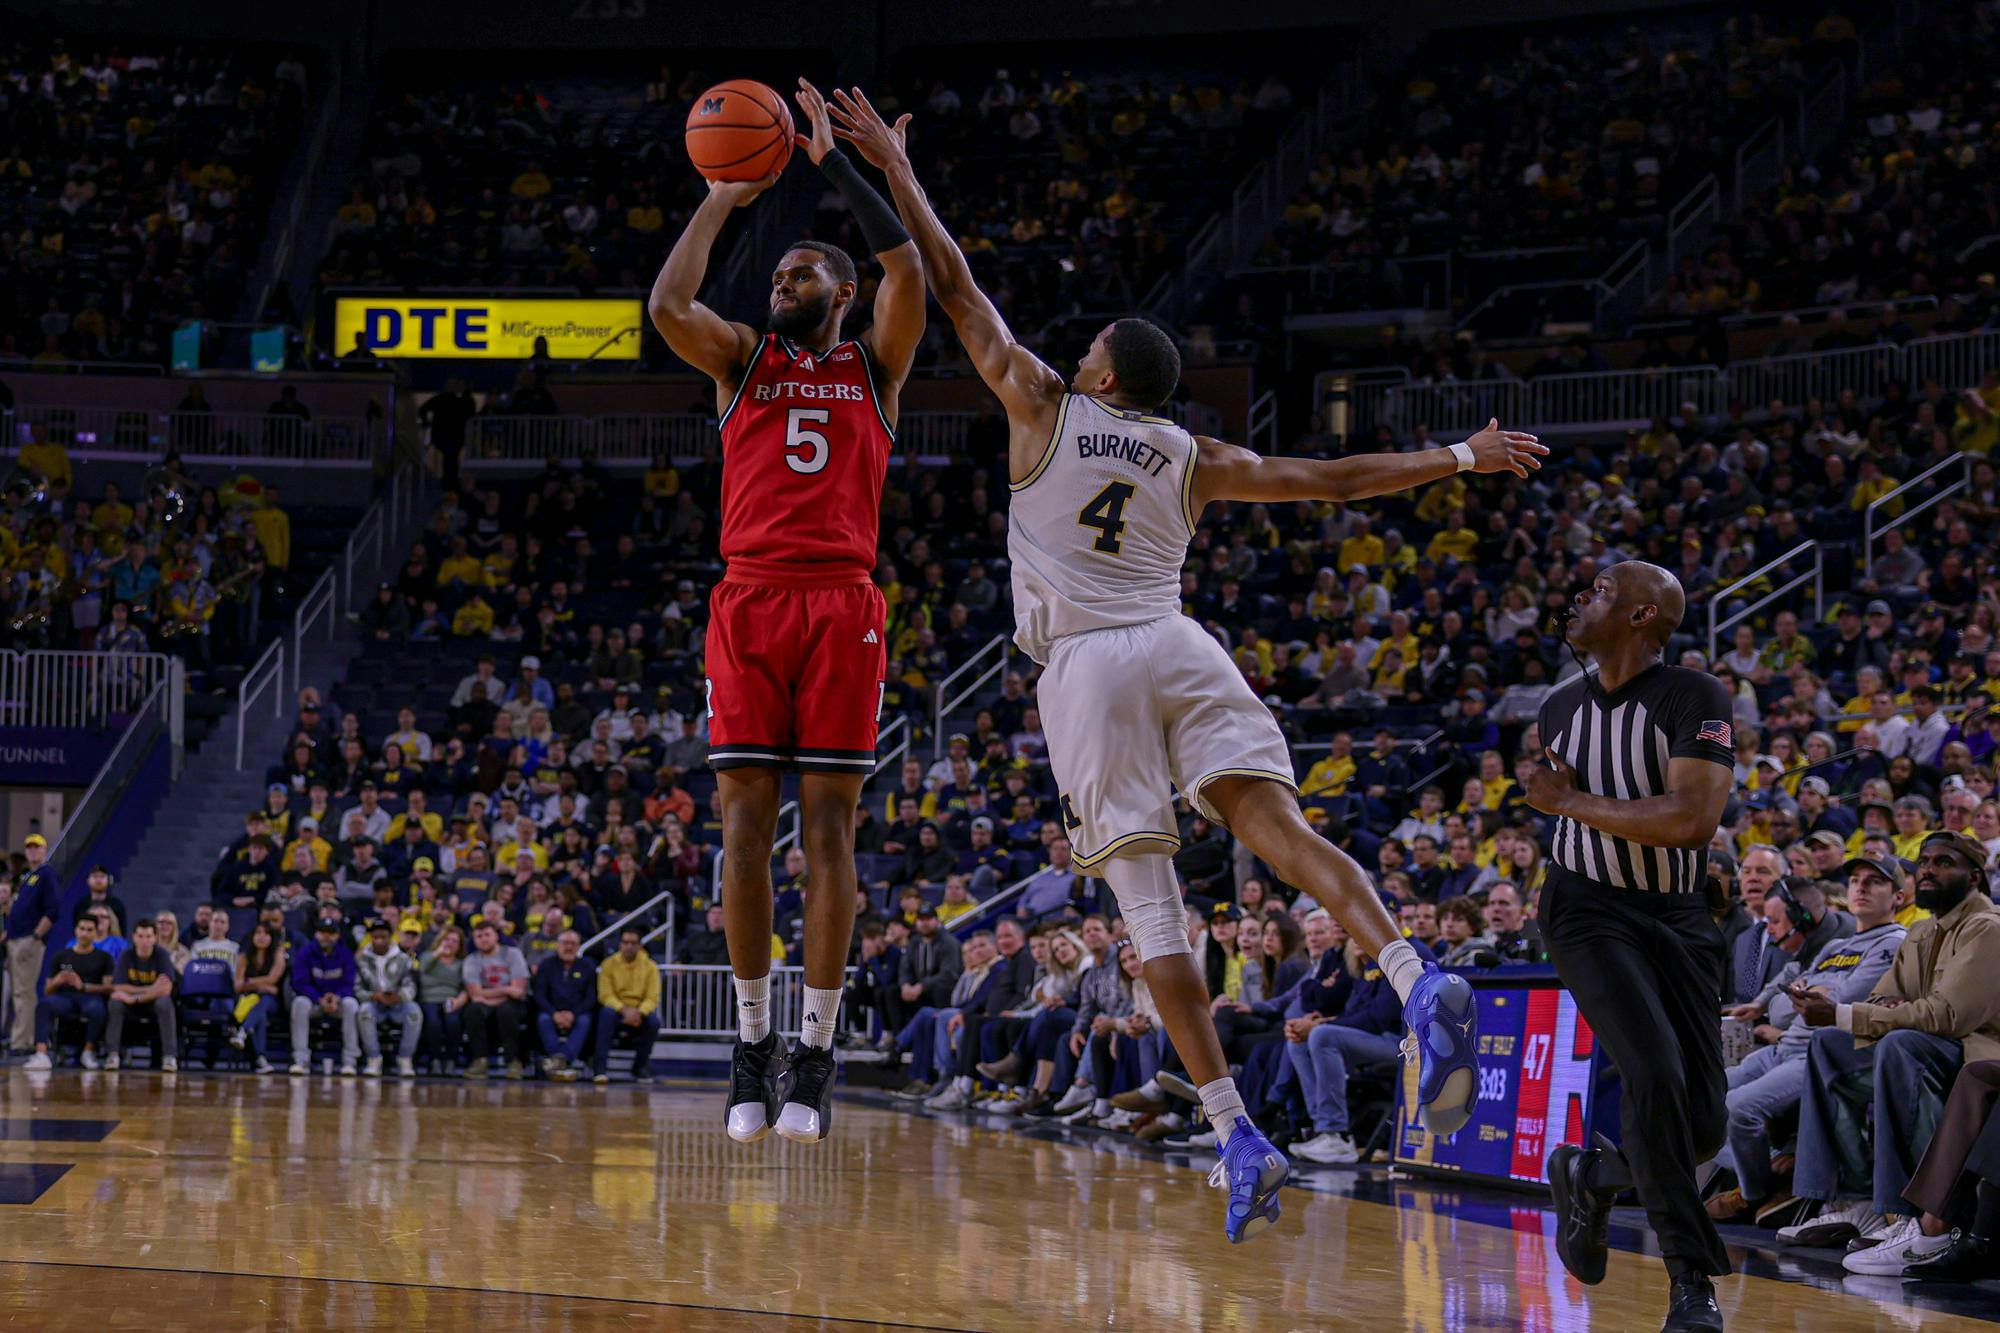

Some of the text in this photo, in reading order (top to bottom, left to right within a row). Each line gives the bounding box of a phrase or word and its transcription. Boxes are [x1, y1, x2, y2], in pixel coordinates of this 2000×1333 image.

[700, 97, 725, 115] M
[364, 308, 489, 350] DTE
[754, 381, 864, 401] RUTGERS
[784, 407, 830, 474] 5
[1077, 433, 1172, 477] BURNETT
[1076, 480, 1137, 557] 4
[1523, 1034, 1551, 1081] 47
